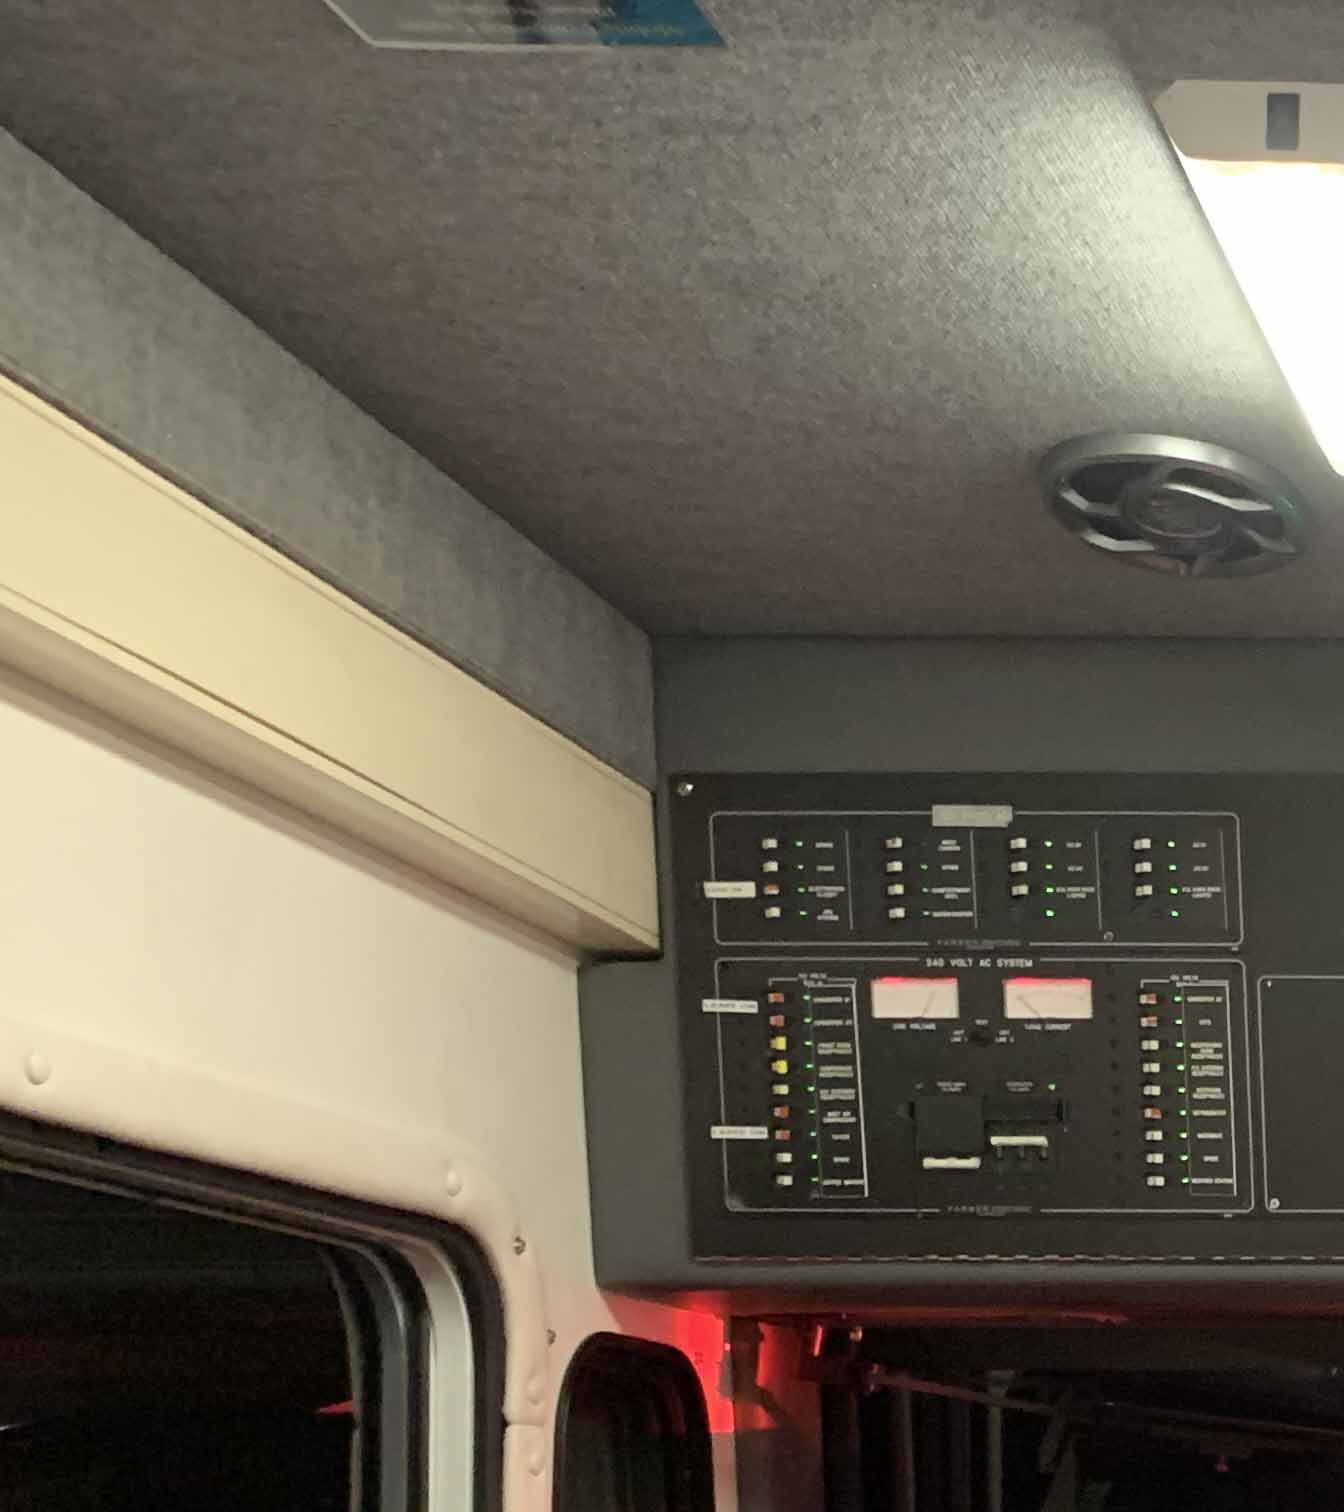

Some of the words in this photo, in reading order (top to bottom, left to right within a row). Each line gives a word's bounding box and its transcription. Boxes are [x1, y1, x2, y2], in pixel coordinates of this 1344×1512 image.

[950, 958, 973, 967] VOLT
[979, 958, 991, 967] AC
[996, 958, 1033, 968] SYSTEM
